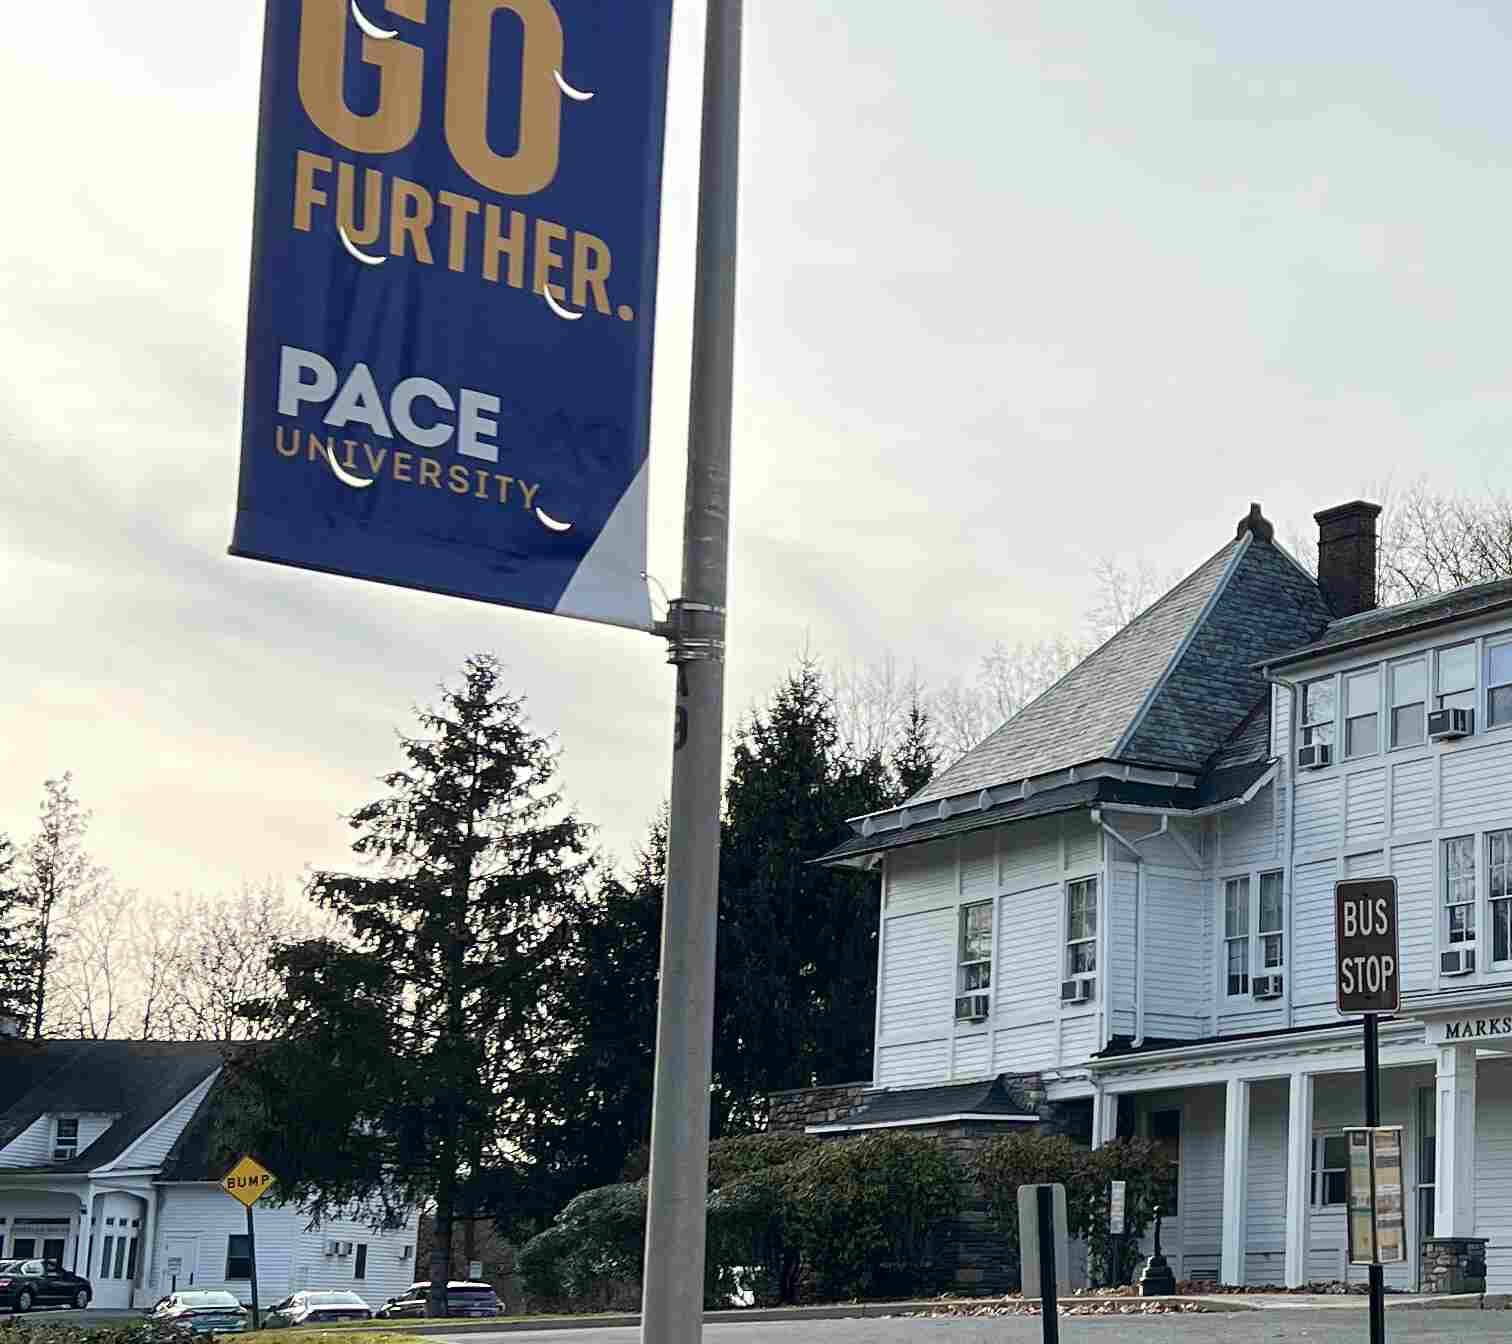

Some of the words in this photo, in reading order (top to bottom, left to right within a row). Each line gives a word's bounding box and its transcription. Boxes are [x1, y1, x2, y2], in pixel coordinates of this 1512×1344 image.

[293, 149, 635, 322] FURTHER.
[277, 344, 501, 463] PACE
[275, 424, 540, 510] UNIVERSITY
[1343, 898, 1388, 937] BUS
[1341, 955, 1394, 995] STOP
[1445, 1016, 1512, 1040] MARKS
[227, 1174, 270, 1189] BUMP
